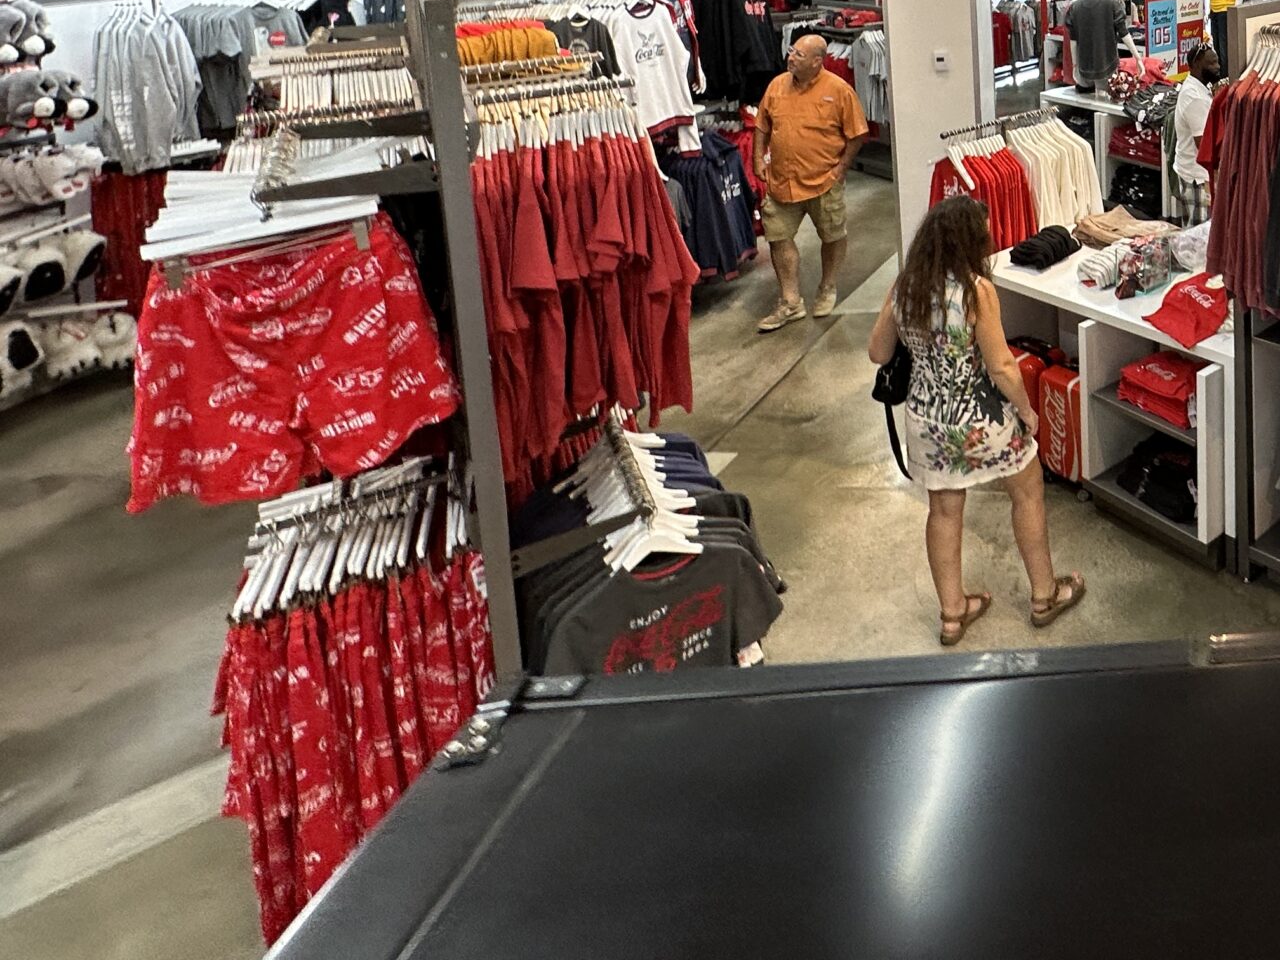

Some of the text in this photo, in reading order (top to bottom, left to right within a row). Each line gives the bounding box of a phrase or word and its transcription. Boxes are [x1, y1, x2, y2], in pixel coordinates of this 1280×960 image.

[1045, 380, 1066, 477] Coca-Cola
[629, 605, 669, 630] ENJOY
[682, 625, 713, 649] SINCE
